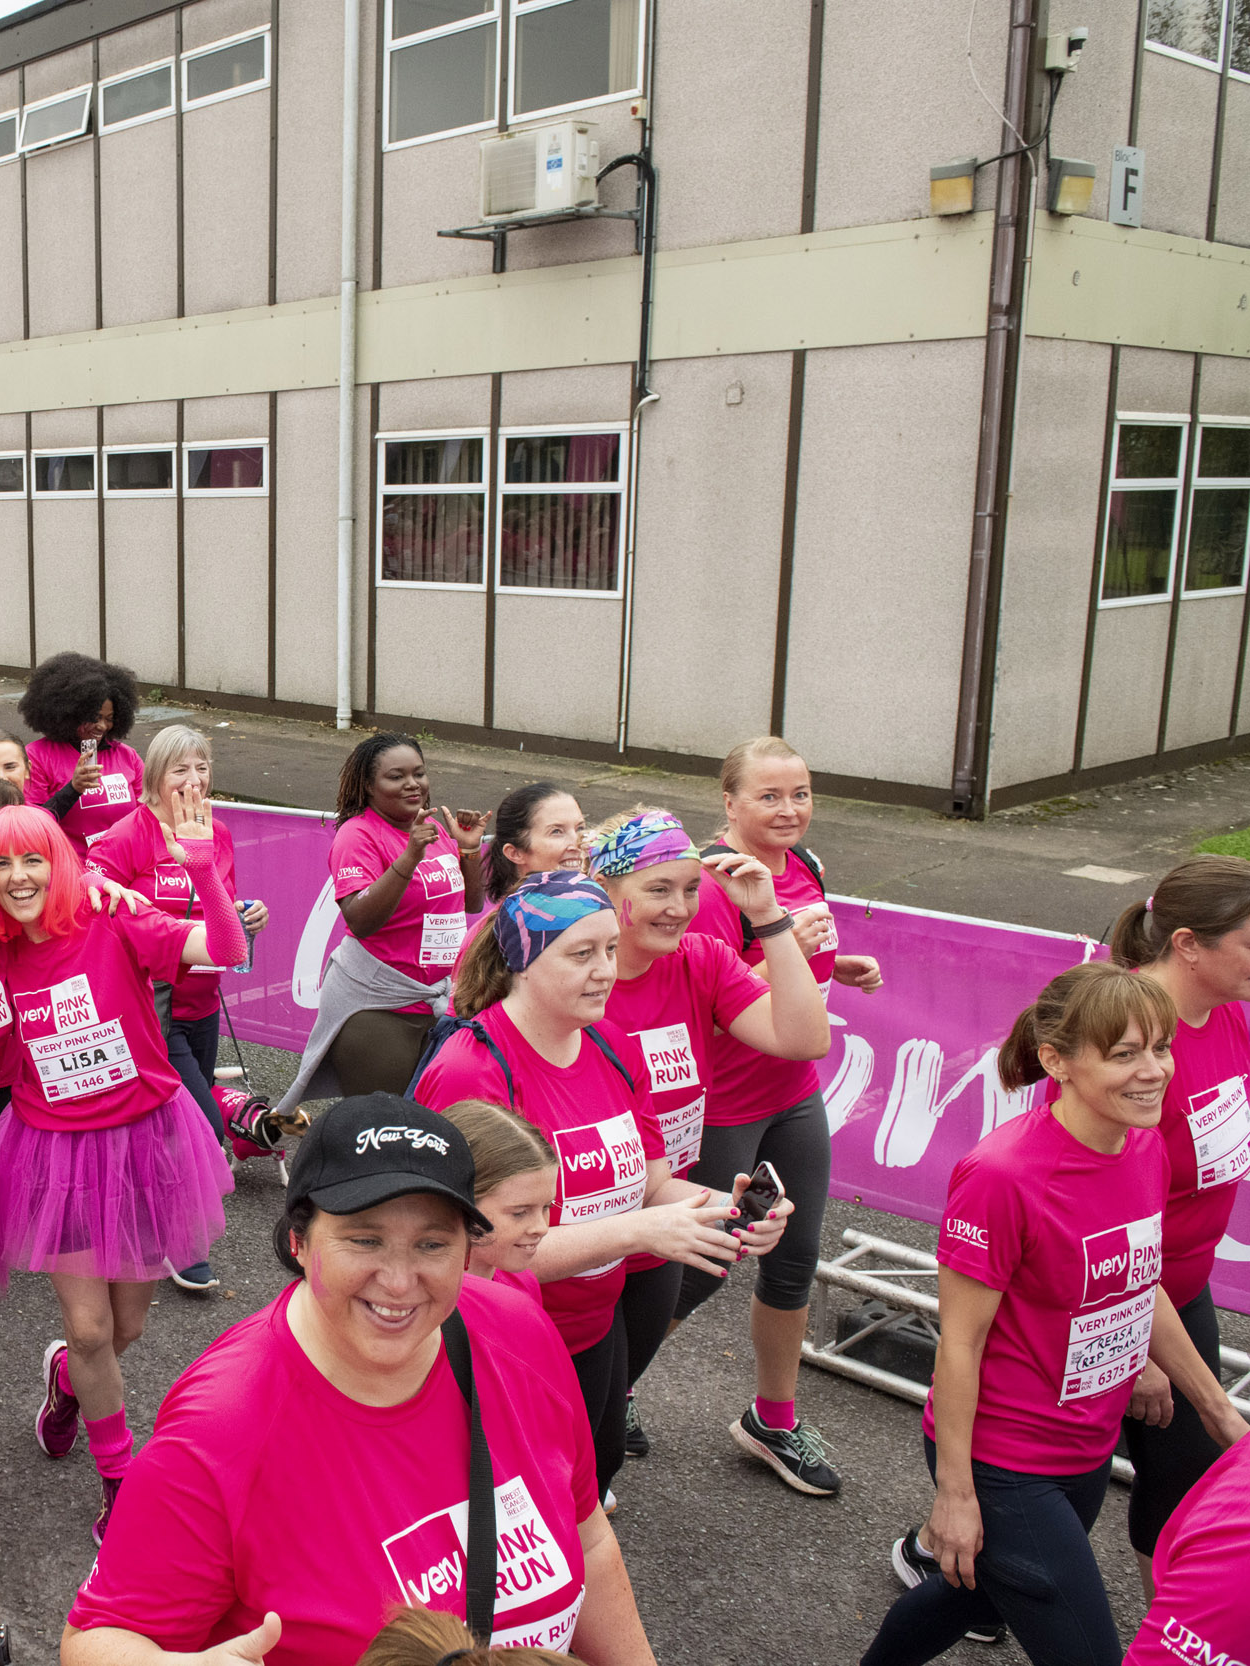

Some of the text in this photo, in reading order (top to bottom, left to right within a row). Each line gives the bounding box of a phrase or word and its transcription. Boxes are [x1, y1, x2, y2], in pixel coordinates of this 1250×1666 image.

[1123, 168, 1139, 210] F
[107, 782, 127, 792] PINK
[109, 791, 127, 800] RUN
[159, 875, 186, 888] very
[424, 870, 446, 883] very
[430, 917, 448, 927] VERY
[19, 1005, 51, 1024] very
[56, 993, 90, 1014] PINK
[58, 1008, 90, 1028] RUN
[36, 1026, 116, 1055] VERY PINK RUN
[649, 1046, 691, 1067] PINK
[74, 1075, 104, 1092] 1446
[655, 1064, 690, 1085] RUN
[660, 1104, 701, 1128] INK RUN
[1196, 1087, 1243, 1128] VERY PINK RUN
[356, 1126, 450, 1156] New York
[611, 1137, 642, 1161] PINK
[565, 1148, 606, 1172] very
[618, 1155, 644, 1180] RUN
[1230, 1150, 1248, 1172] 2102
[571, 1202, 601, 1217] VERY
[604, 1194, 628, 1210] PINK
[947, 1218, 989, 1244] UPMC
[1091, 1252, 1127, 1280] very
[1132, 1260, 1160, 1284] RUN
[1078, 1295, 1151, 1334] VERY PINK RUN
[1085, 1325, 1132, 1353] TREASA
[1098, 1363, 1125, 1386] 6375
[496, 1518, 548, 1563] INK
[407, 1550, 463, 1605] very
